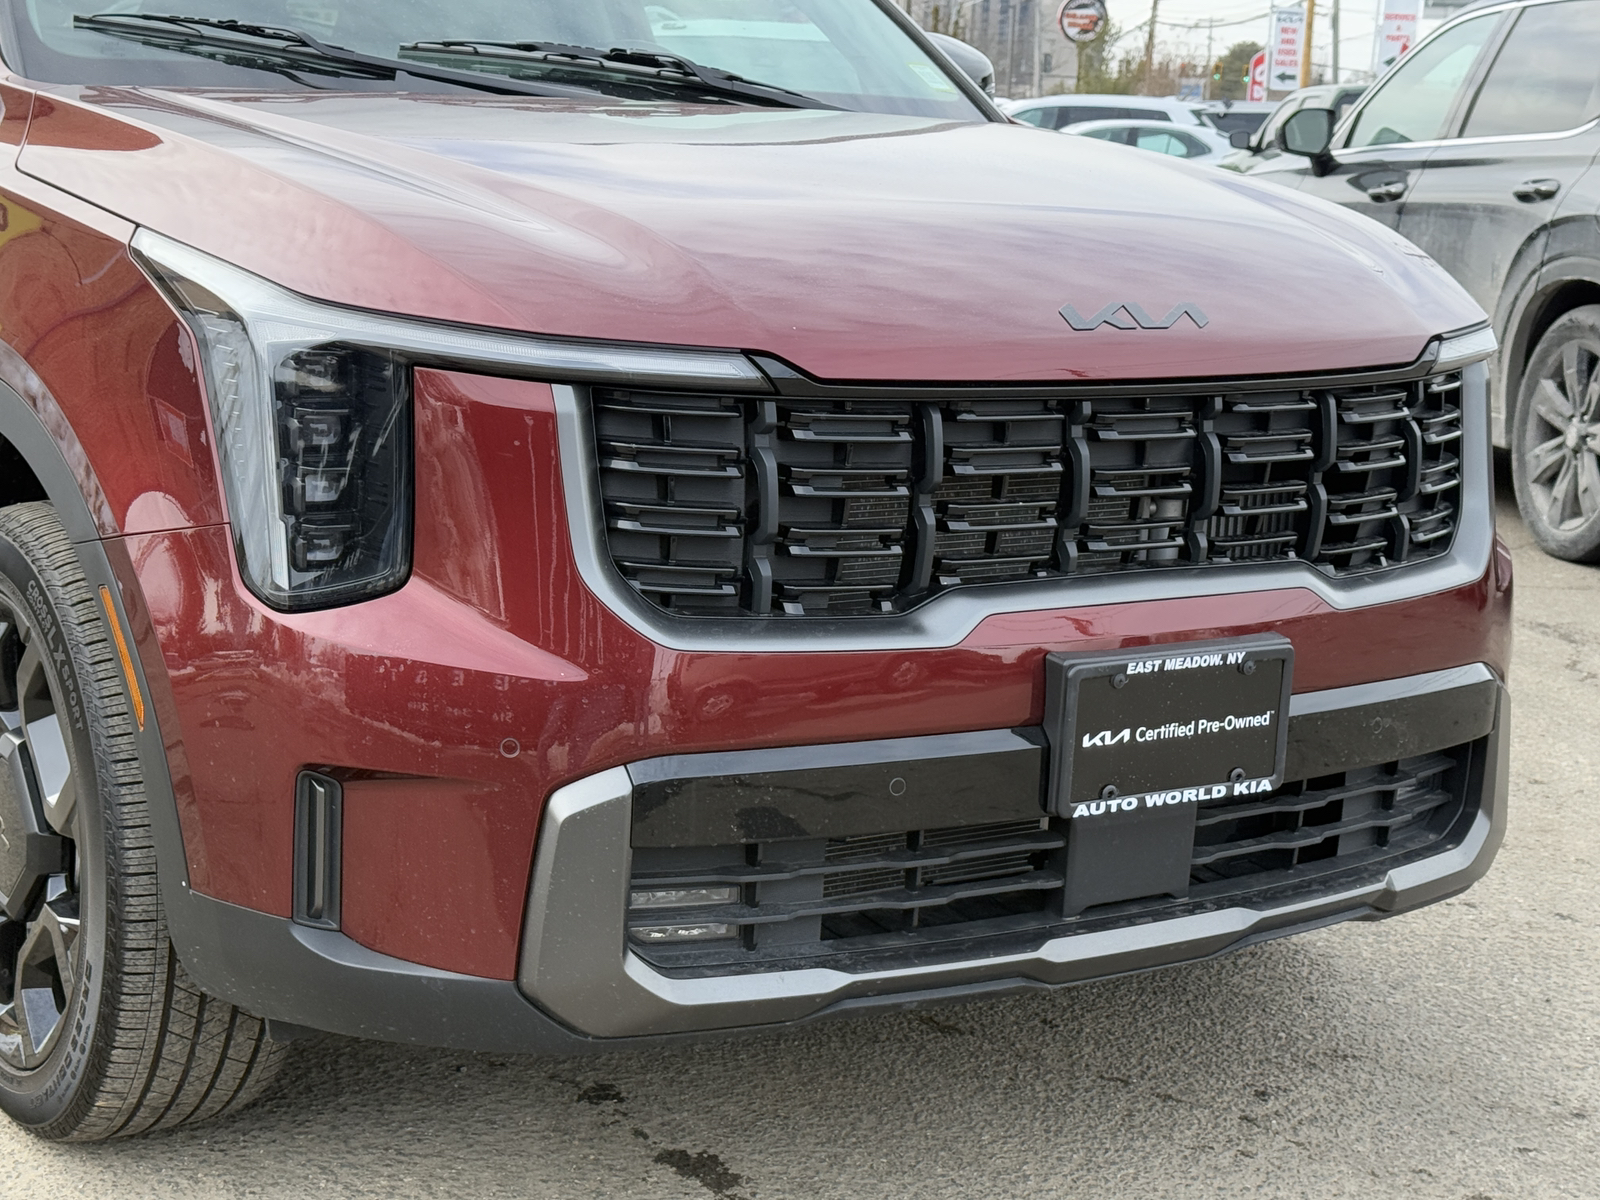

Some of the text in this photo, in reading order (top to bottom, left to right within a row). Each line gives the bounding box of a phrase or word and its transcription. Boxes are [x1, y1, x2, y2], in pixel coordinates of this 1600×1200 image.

[1058, 302, 1209, 331] KIA
[28, 579, 84, 731] CROSS LX SPORT
[1126, 659, 1162, 675] EAST
[1226, 651, 1247, 665] NY
[1082, 728, 1131, 748] KIA
[1135, 721, 1195, 743] Certified
[1072, 779, 1273, 818] AUTO WORLD KIA
